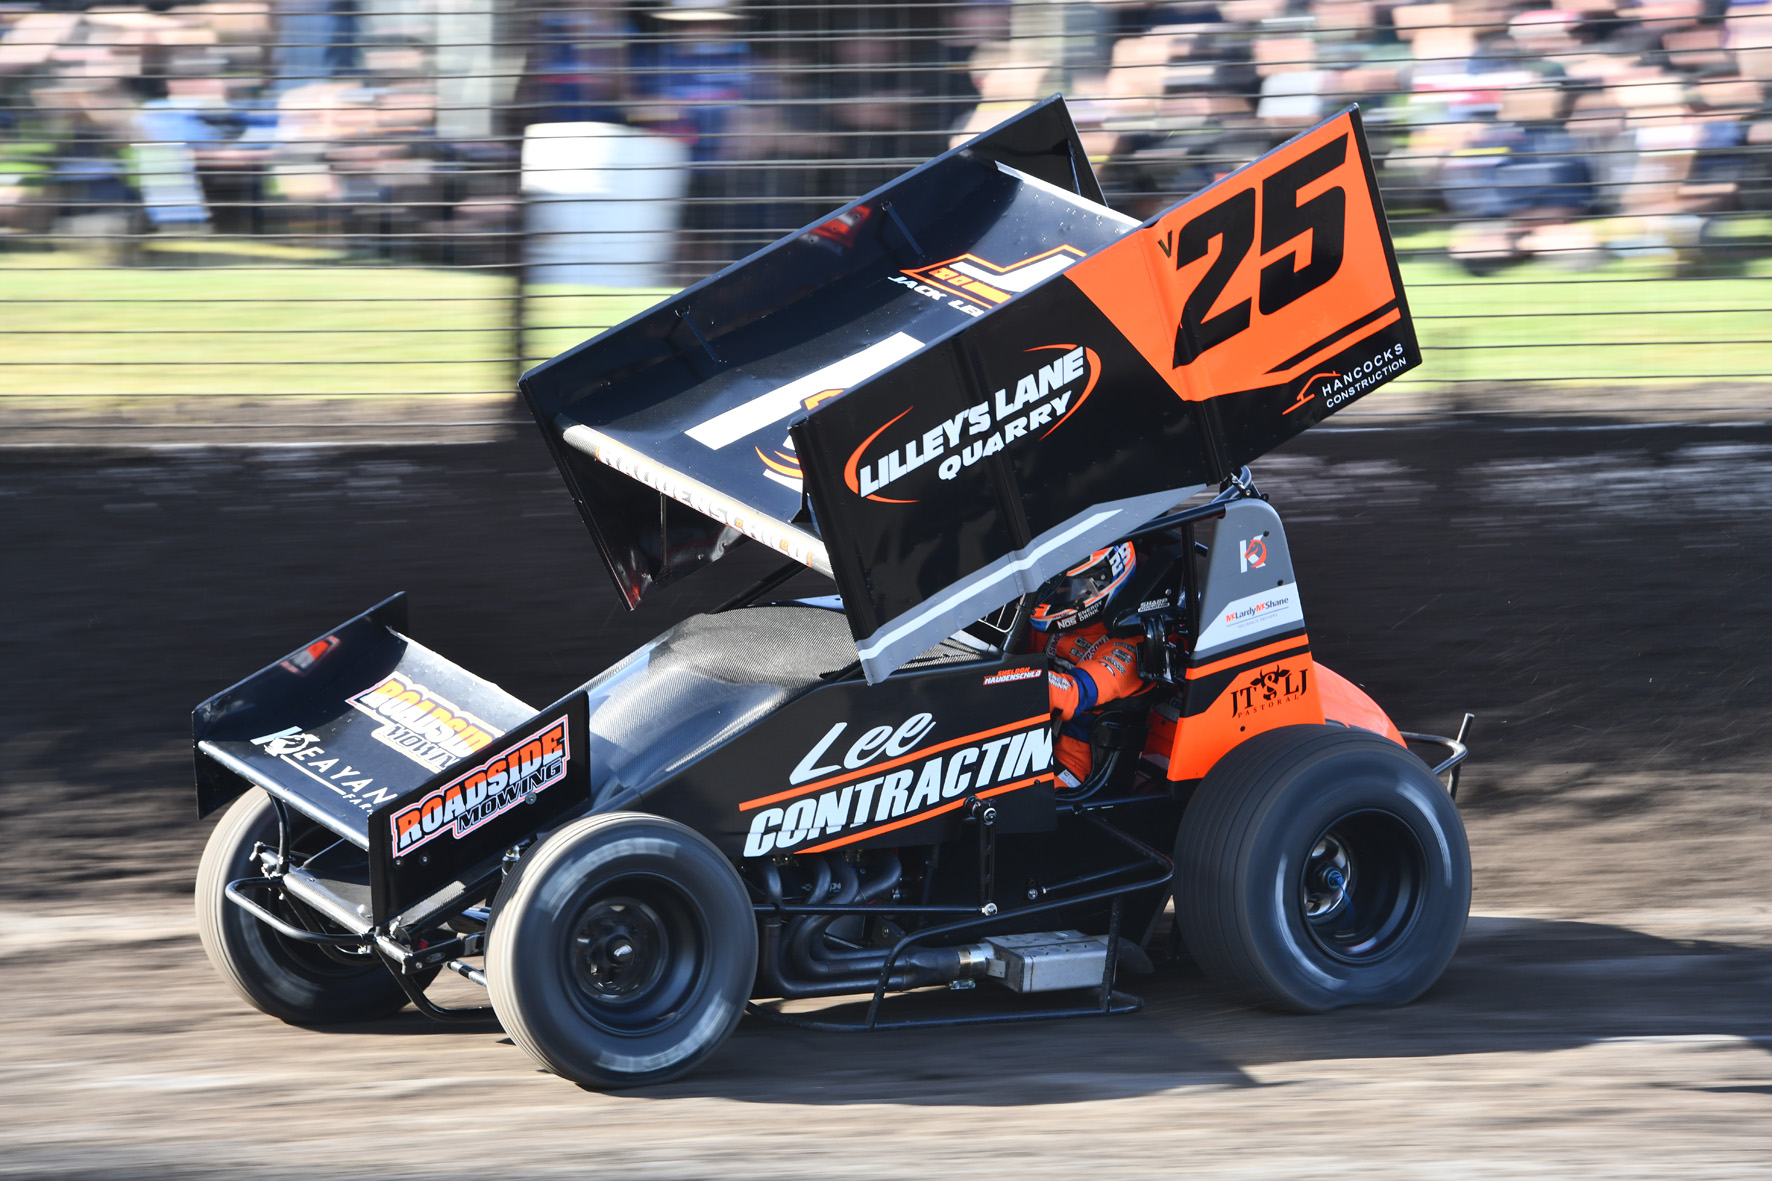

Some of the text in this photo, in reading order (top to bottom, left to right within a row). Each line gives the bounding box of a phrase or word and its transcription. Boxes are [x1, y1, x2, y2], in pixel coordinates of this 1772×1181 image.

[1172, 131, 1349, 370] 25
[887, 276, 947, 300] JACK
[1321, 343, 1404, 396] HANCOCKS
[1326, 356, 1407, 408] CONSTRUCTION
[860, 346, 1084, 498] LILLEY'S LANE
[938, 390, 1072, 481] QUARRY
[1109, 542, 1131, 577] 25
[1056, 614, 1077, 630] NOS
[1078, 601, 1102, 617] ENERGY
[1079, 609, 1099, 622] DRINK
[984, 669, 1042, 685] HAUDENSCHILD
[1237, 694, 1299, 718] PASTORAL
[789, 712, 936, 785] Lee
[397, 725, 564, 848] ROADSIDE
[457, 759, 564, 833] MOWING
